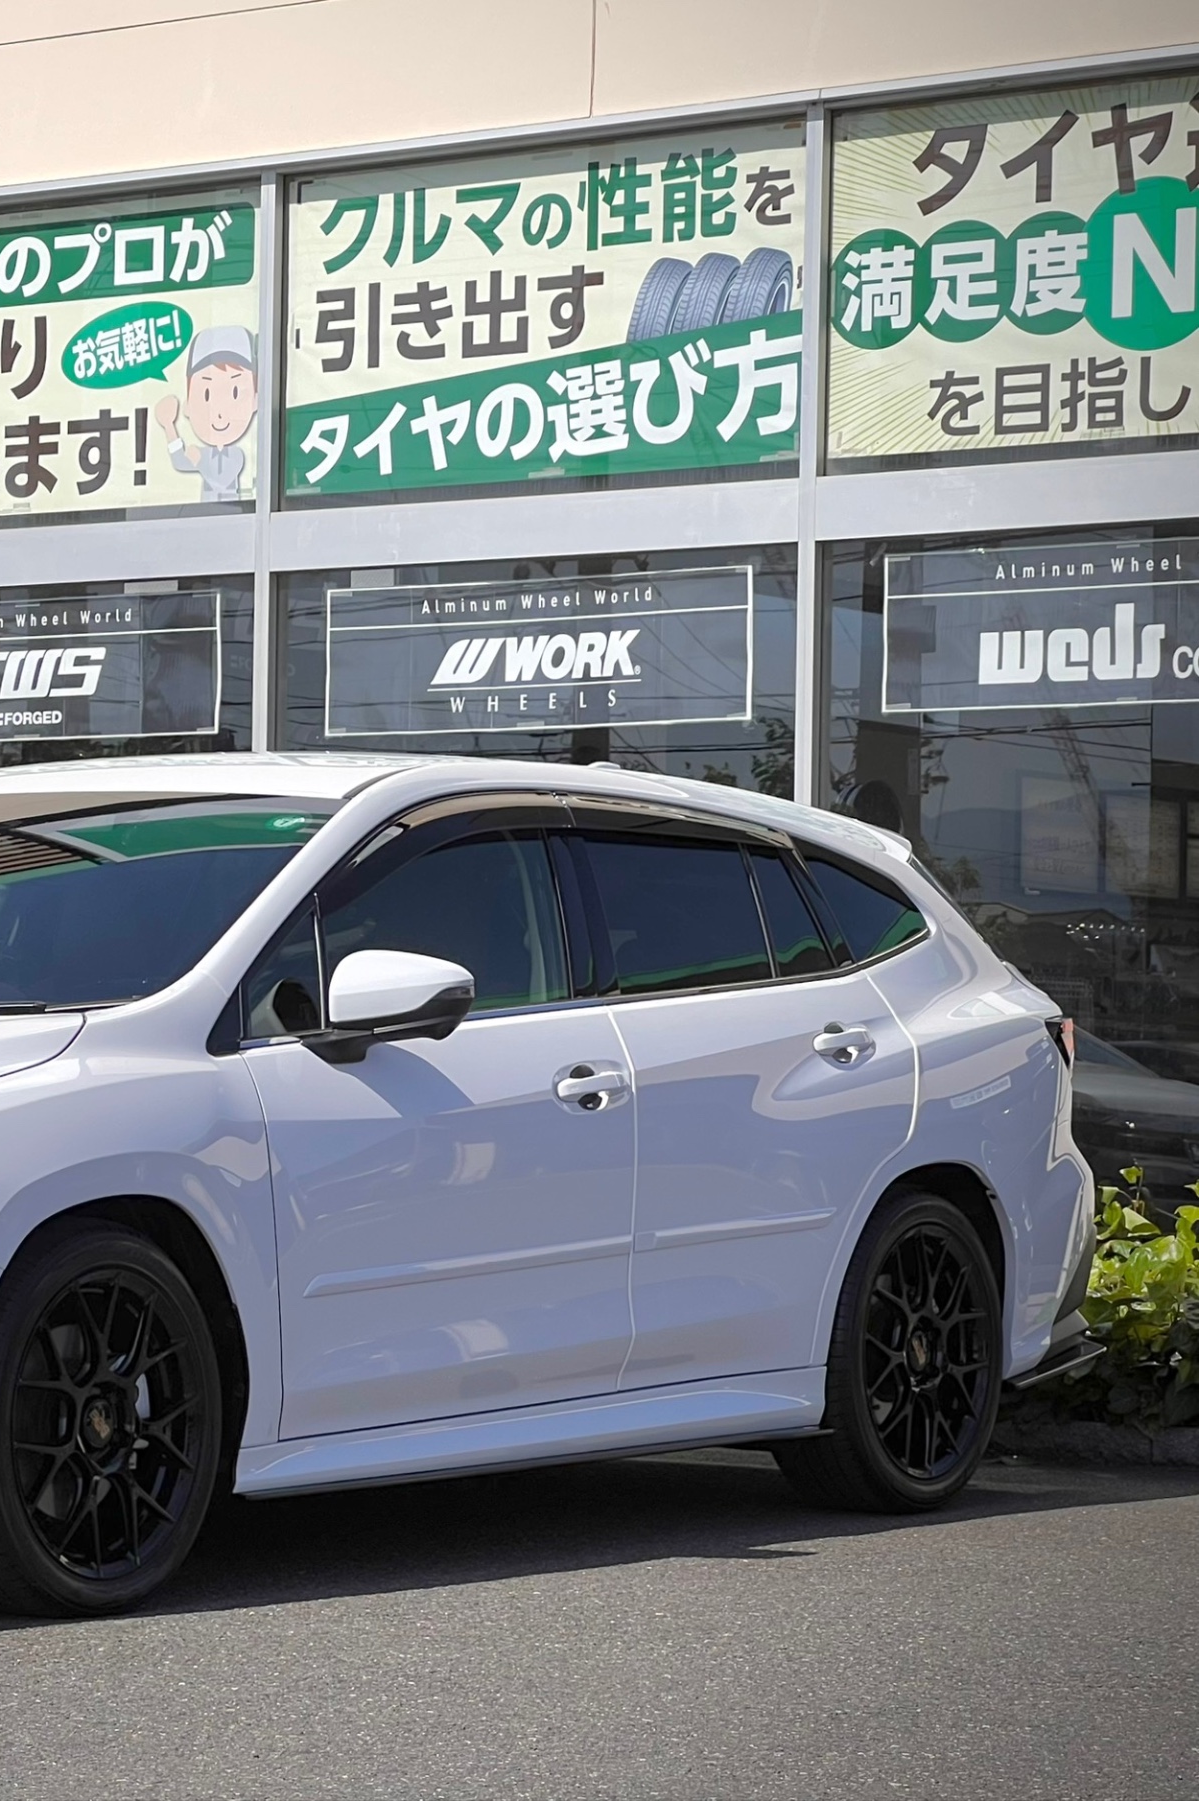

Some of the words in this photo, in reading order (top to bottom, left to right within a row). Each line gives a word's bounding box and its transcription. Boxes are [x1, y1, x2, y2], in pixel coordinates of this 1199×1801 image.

[912, 90, 1199, 217] タイヤ
[319, 147, 796, 275] クルマの性能を
[71, 309, 183, 380] お気軽に!
[315, 265, 605, 373] 引き出す
[300, 328, 802, 485] タイヤの選び方
[927, 356, 1192, 436] を目指し
[421, 597, 507, 615] Alminum
[520, 591, 581, 609] Wheel
[594, 587, 653, 604] World
[995, 561, 1094, 580] Alminum
[1110, 554, 1182, 574] Wheel
[15, 611, 68, 628] Wheel
[80, 608, 132, 624] World
[978, 602, 1166, 685] weds
[3, 710, 63, 726] FORGED
[450, 688, 617, 714] WHEELS
